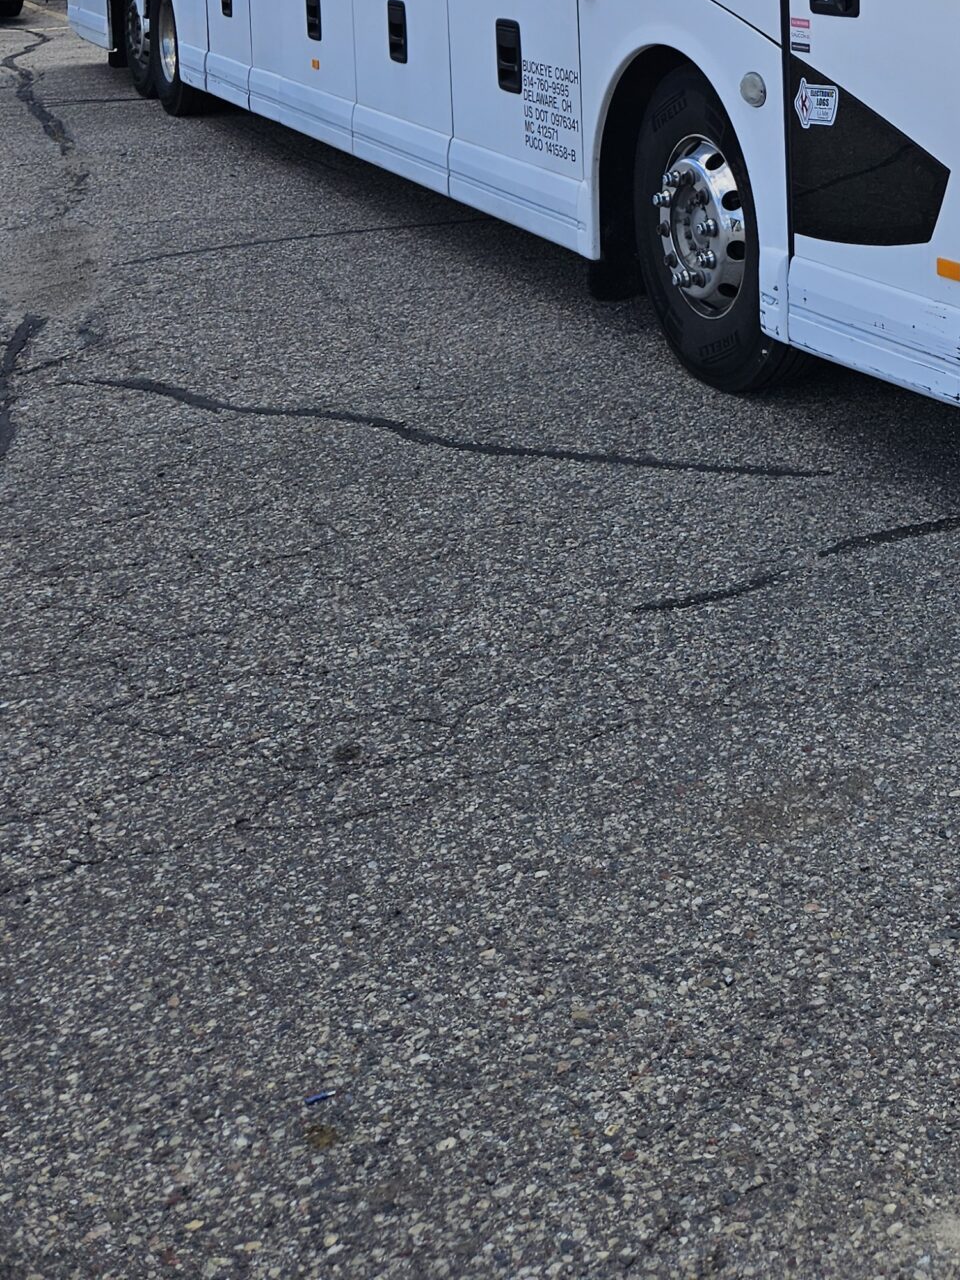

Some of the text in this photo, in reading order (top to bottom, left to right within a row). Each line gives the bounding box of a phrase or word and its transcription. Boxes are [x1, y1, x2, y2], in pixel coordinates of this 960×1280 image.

[522, 59, 579, 84] BUCKEYE COACH
[523, 74, 570, 98] 614-760-9595
[523, 88, 572, 113] DELAWARE, OH
[816, 97, 830, 107] LOGS
[523, 104, 579, 133] US DOT 0976341
[524, 120, 559, 142] MC 412571
[525, 134, 577, 162] PUCO 141558-B
